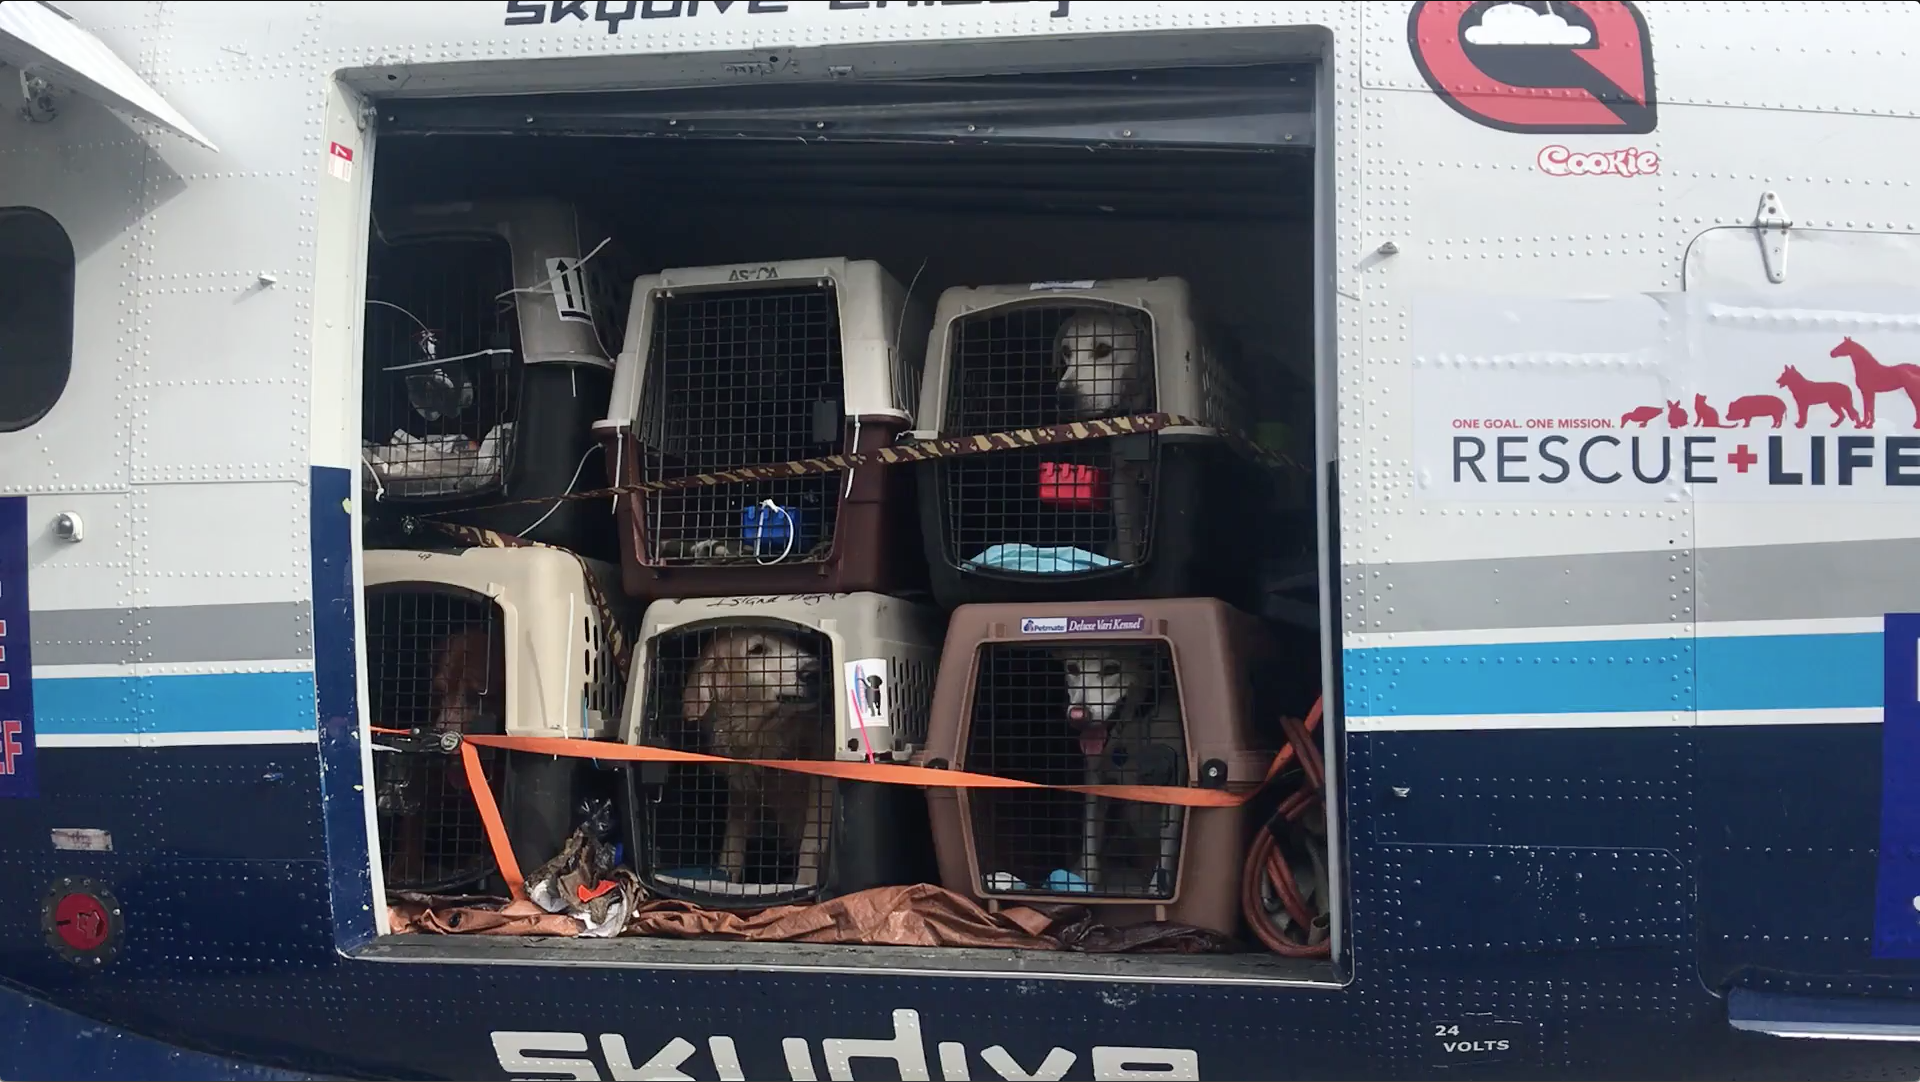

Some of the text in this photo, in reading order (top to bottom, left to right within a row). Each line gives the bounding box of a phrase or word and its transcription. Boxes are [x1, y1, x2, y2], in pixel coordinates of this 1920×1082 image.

[1452, 419, 1615, 429] ONE GOAL. ONE MISSION.
[1068, 620, 1096, 631] Deluxe
[1097, 619, 1112, 630] Vari
[1113, 618, 1141, 630] Kennel
[1435, 1025, 1460, 1036] 24
[1443, 1040, 1510, 1053] VOLTS
